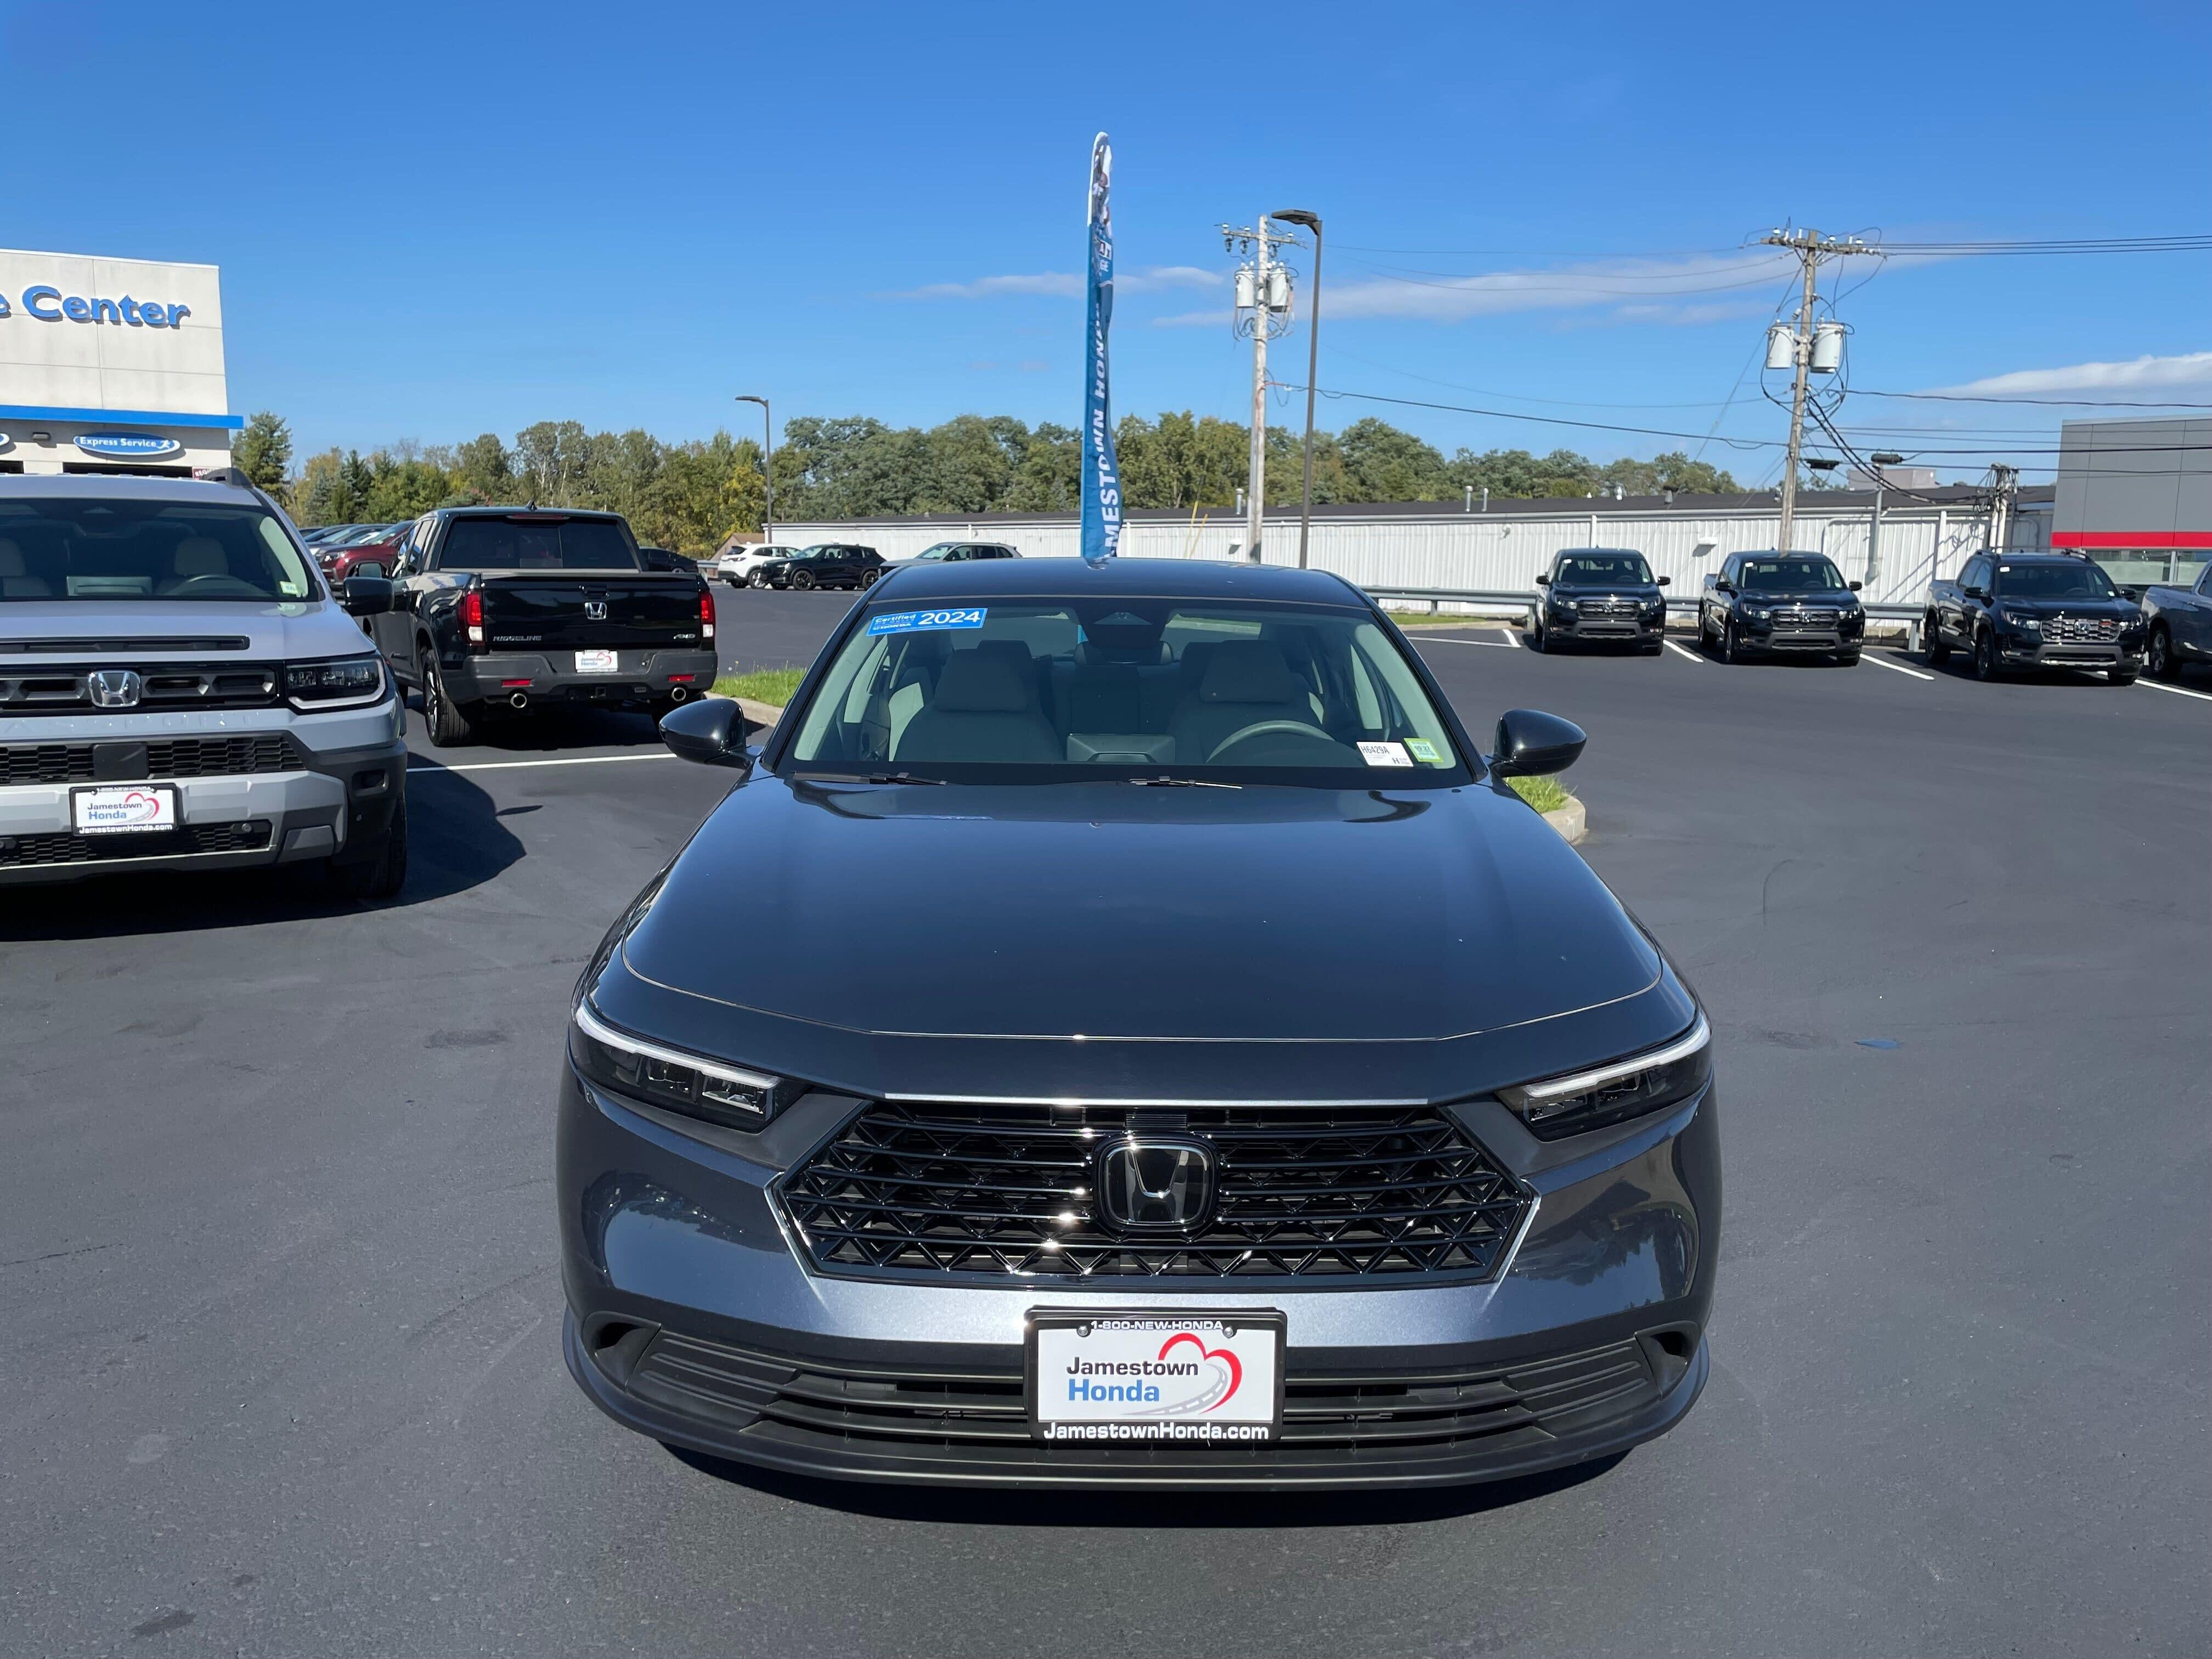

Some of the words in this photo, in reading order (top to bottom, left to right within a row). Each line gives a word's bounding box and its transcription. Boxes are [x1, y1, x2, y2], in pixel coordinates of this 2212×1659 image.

[22, 285, 190, 328] Center
[80, 437, 118, 447] Express
[120, 438, 157, 448] Service
[1093, 408, 1120, 557] MESTOWN
[918, 611, 980, 625] 2024
[1360, 746, 1390, 754] H6429A
[89, 810, 127, 820] Honda
[79, 824, 173, 834] JamestownHonda.com
[1090, 1321, 1223, 1330] 1-800-NEW-HONDA
[1066, 1357, 1199, 1376] Jamestown
[1068, 1379, 1160, 1402] Honda
[1043, 1422, 1269, 1440] JamestownHonda.com
